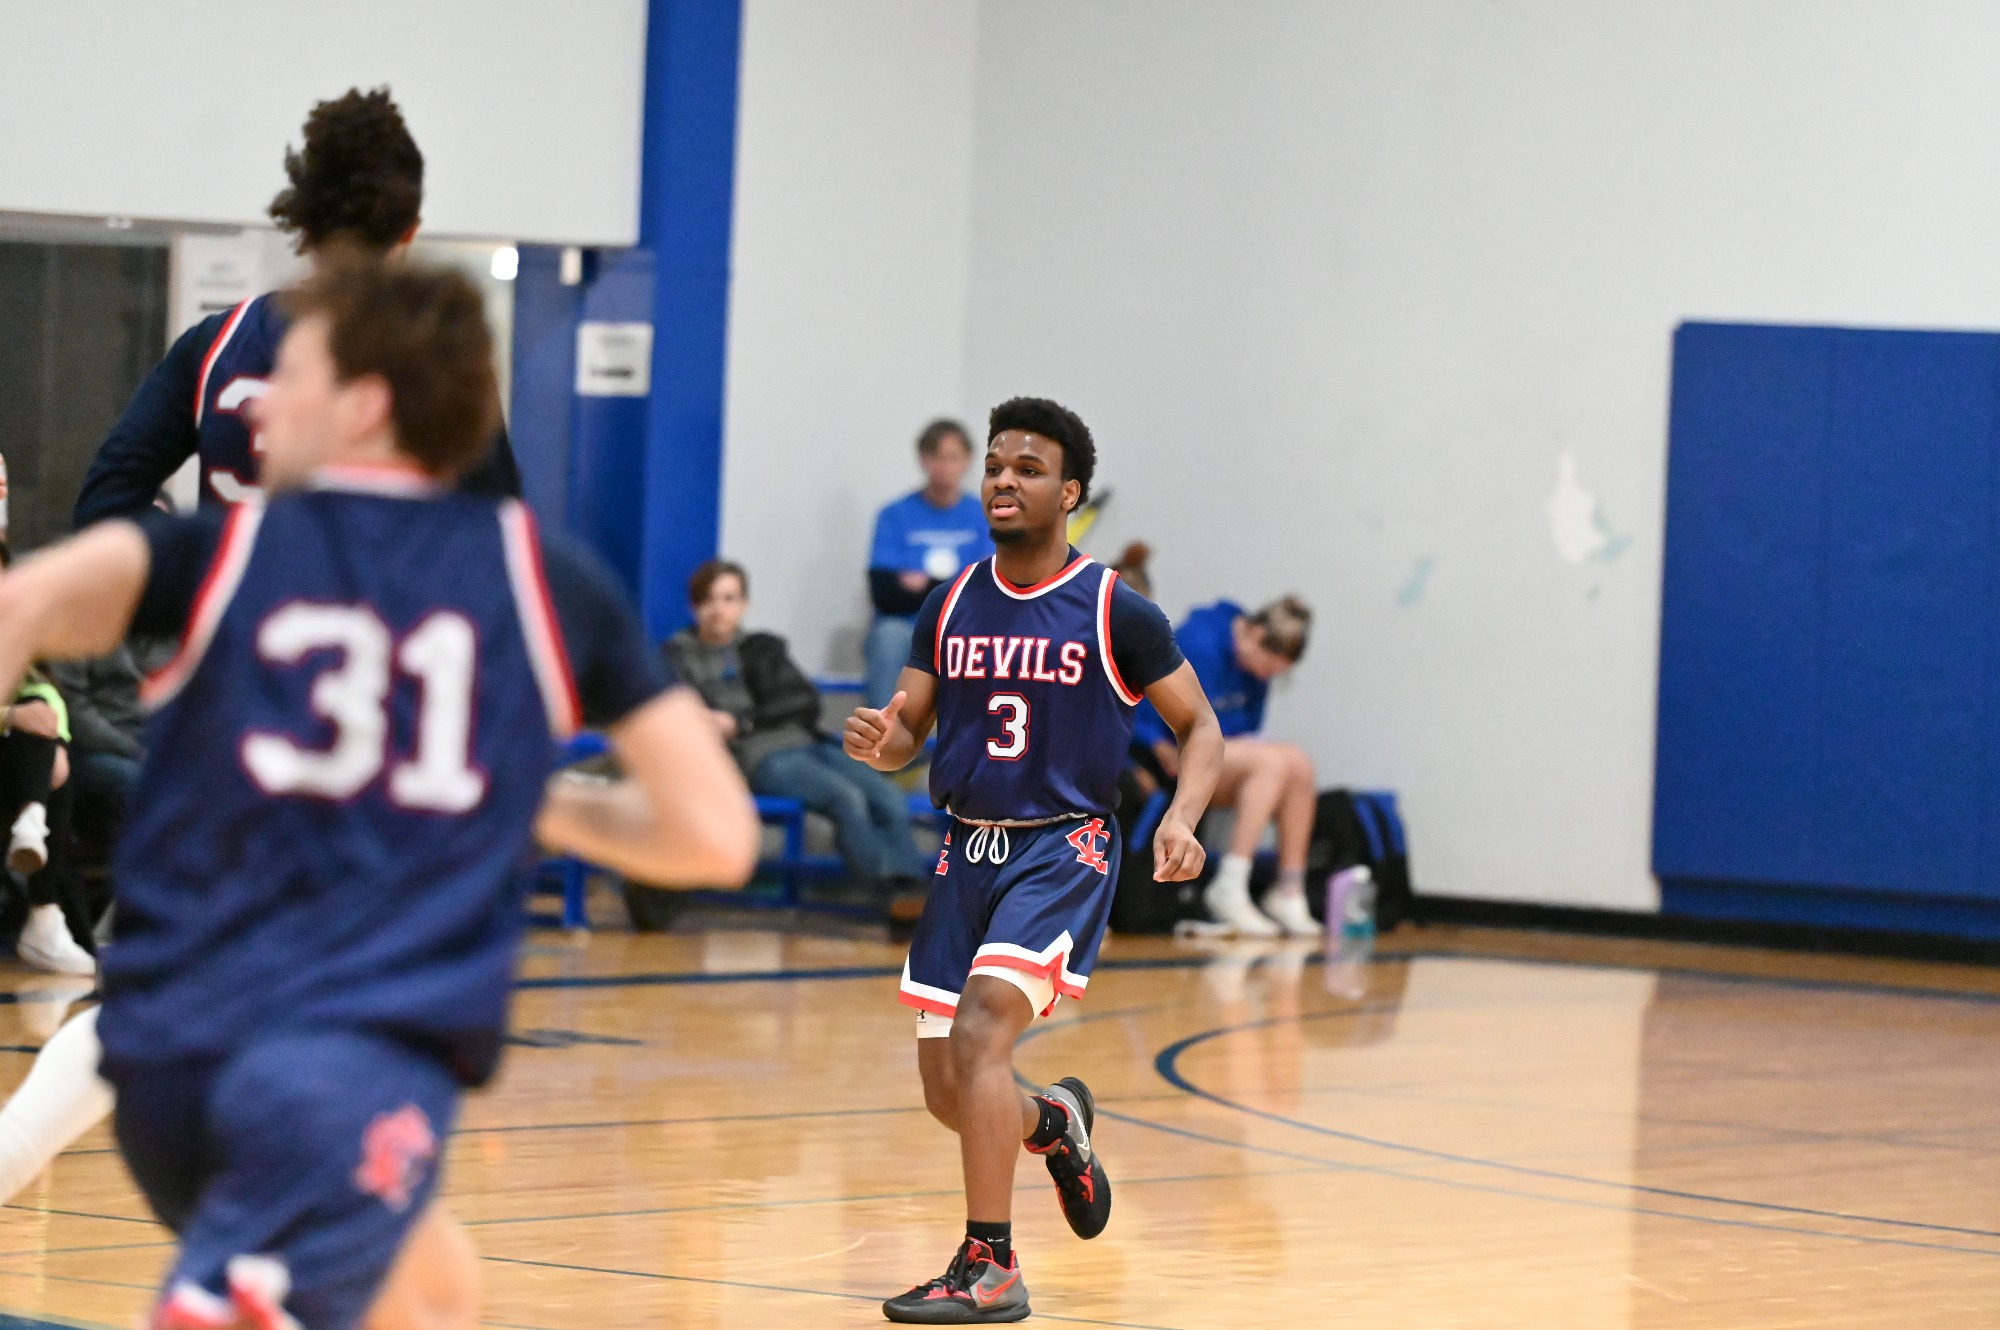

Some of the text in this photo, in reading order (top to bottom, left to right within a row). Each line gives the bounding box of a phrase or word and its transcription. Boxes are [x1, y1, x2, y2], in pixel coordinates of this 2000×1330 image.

[947, 636, 1086, 686] DEVILS
[237, 602, 488, 813] 31
[987, 692, 1031, 762] 3
